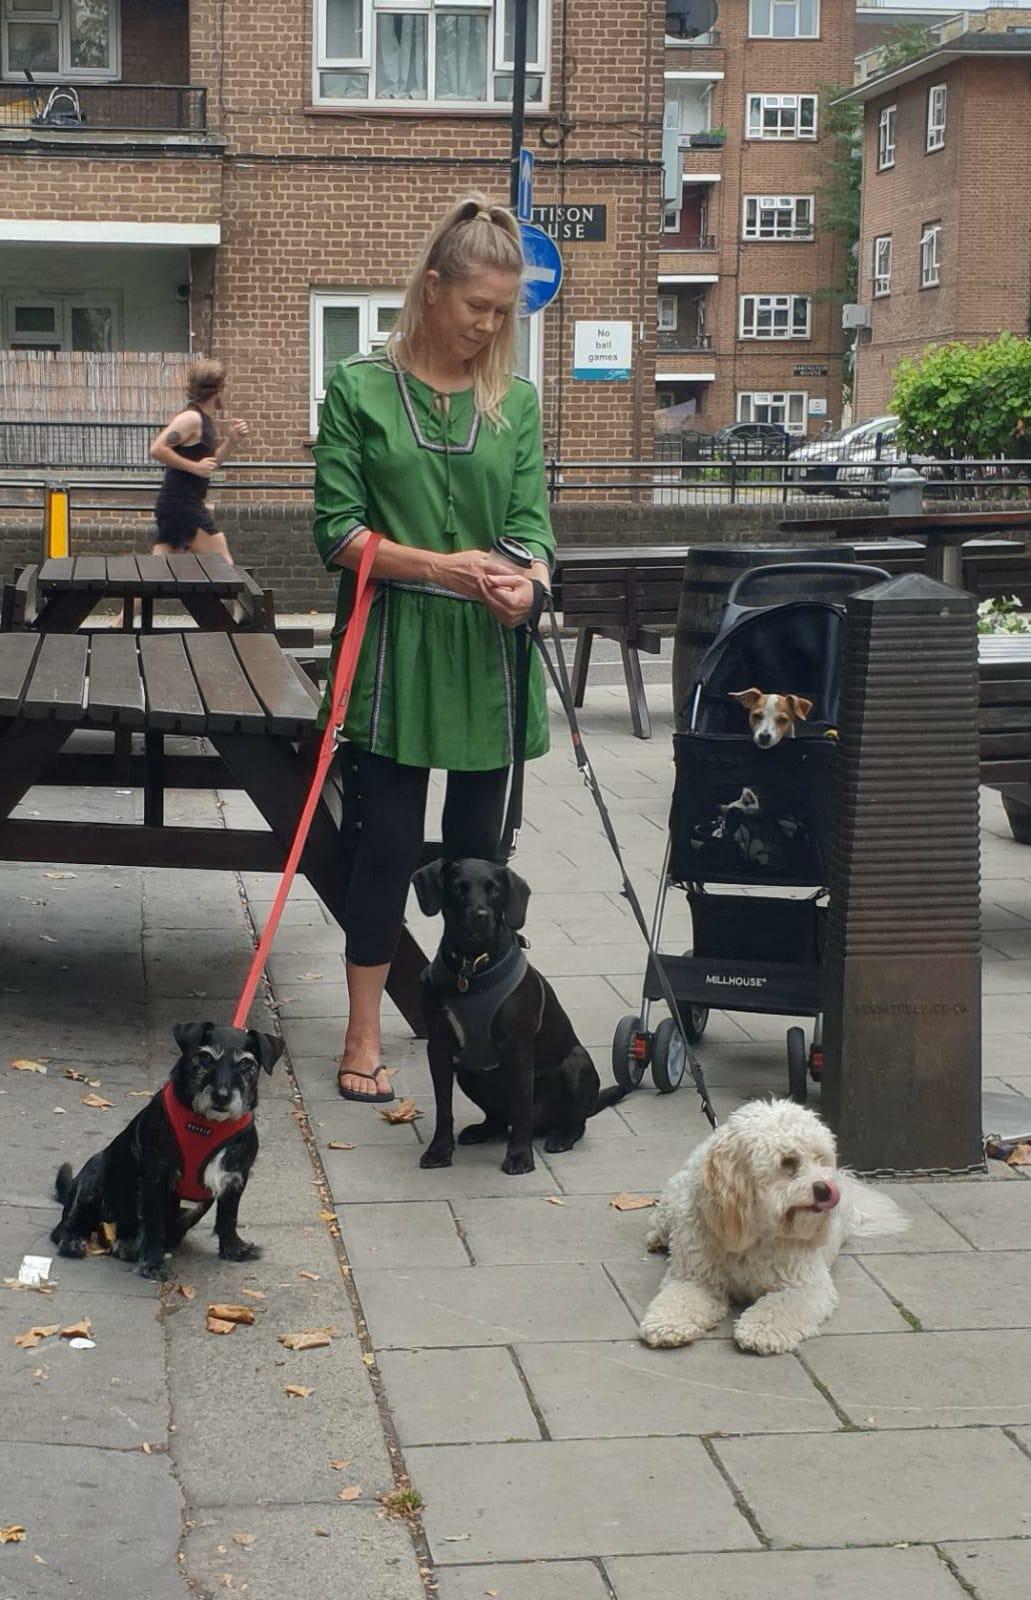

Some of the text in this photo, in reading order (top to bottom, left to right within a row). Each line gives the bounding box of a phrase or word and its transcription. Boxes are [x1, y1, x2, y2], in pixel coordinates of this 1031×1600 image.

[597, 329, 610, 337] No
[595, 341, 612, 349] ball
[588, 354, 618, 363] games
[705, 974, 762, 987] MILLHOUSE
